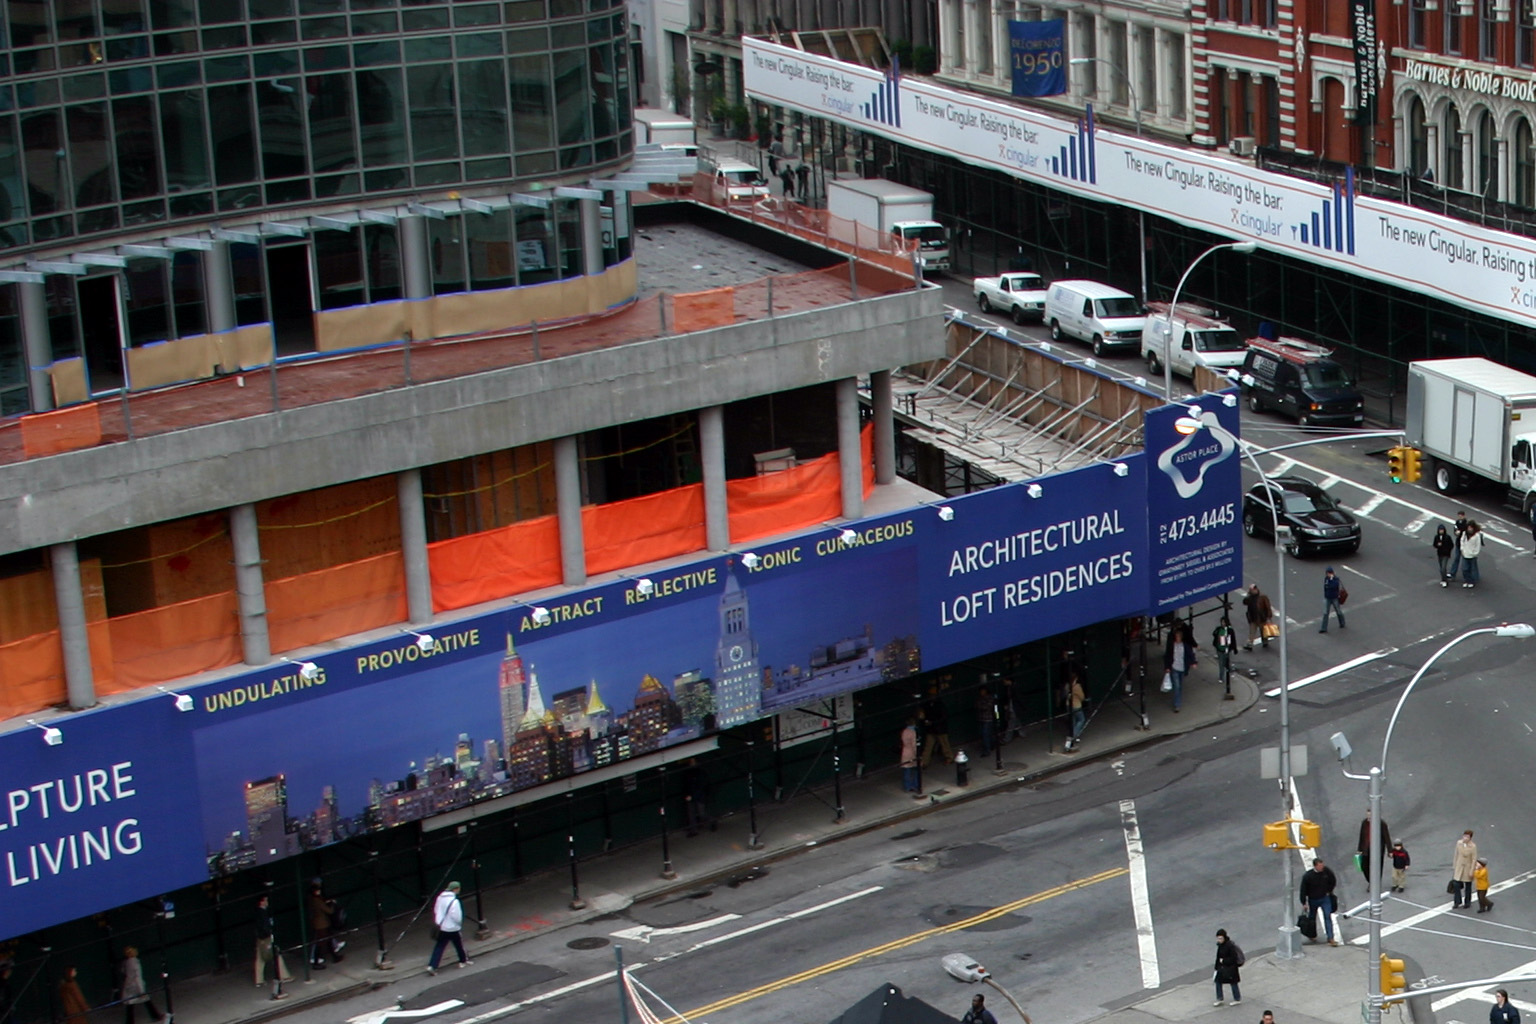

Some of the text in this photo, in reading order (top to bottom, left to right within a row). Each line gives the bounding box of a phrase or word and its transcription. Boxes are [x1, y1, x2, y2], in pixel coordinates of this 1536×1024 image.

[1013, 51, 1062, 75] 1950
[1405, 58, 1450, 86] Barnes
[1452, 67, 1461, 88] &
[1463, 70, 1499, 95] Noble
[914, 95, 929, 115] The
[930, 104, 945, 119] new
[947, 104, 979, 129] Cingular.
[980, 112, 1008, 141] Raising
[1009, 120, 1022, 141] the
[1007, 148, 1038, 169] cingular
[1124, 151, 1142, 172] The
[1143, 162, 1163, 179] new
[1164, 161, 1206, 190] Cingular.
[1208, 171, 1243, 204] Raising
[1244, 182, 1261, 205] the
[1240, 210, 1281, 236] cingular
[1379, 216, 1400, 241] The
[1402, 229, 1426, 247] new
[1428, 229, 1479, 265] Cingular.
[1482, 246, 1526, 282] Raising
[1176, 444, 1219, 464] ASTOR PLACE
[1159, 523, 1168, 545] 212
[1168, 503, 1235, 541] 473.4445
[948, 509, 1125, 577] ARCHITECTURAL
[941, 551, 1133, 627] LOFT RESIDENCES
[205, 668, 327, 713] UNDULATING
[7, 818, 142, 887] LIVING
